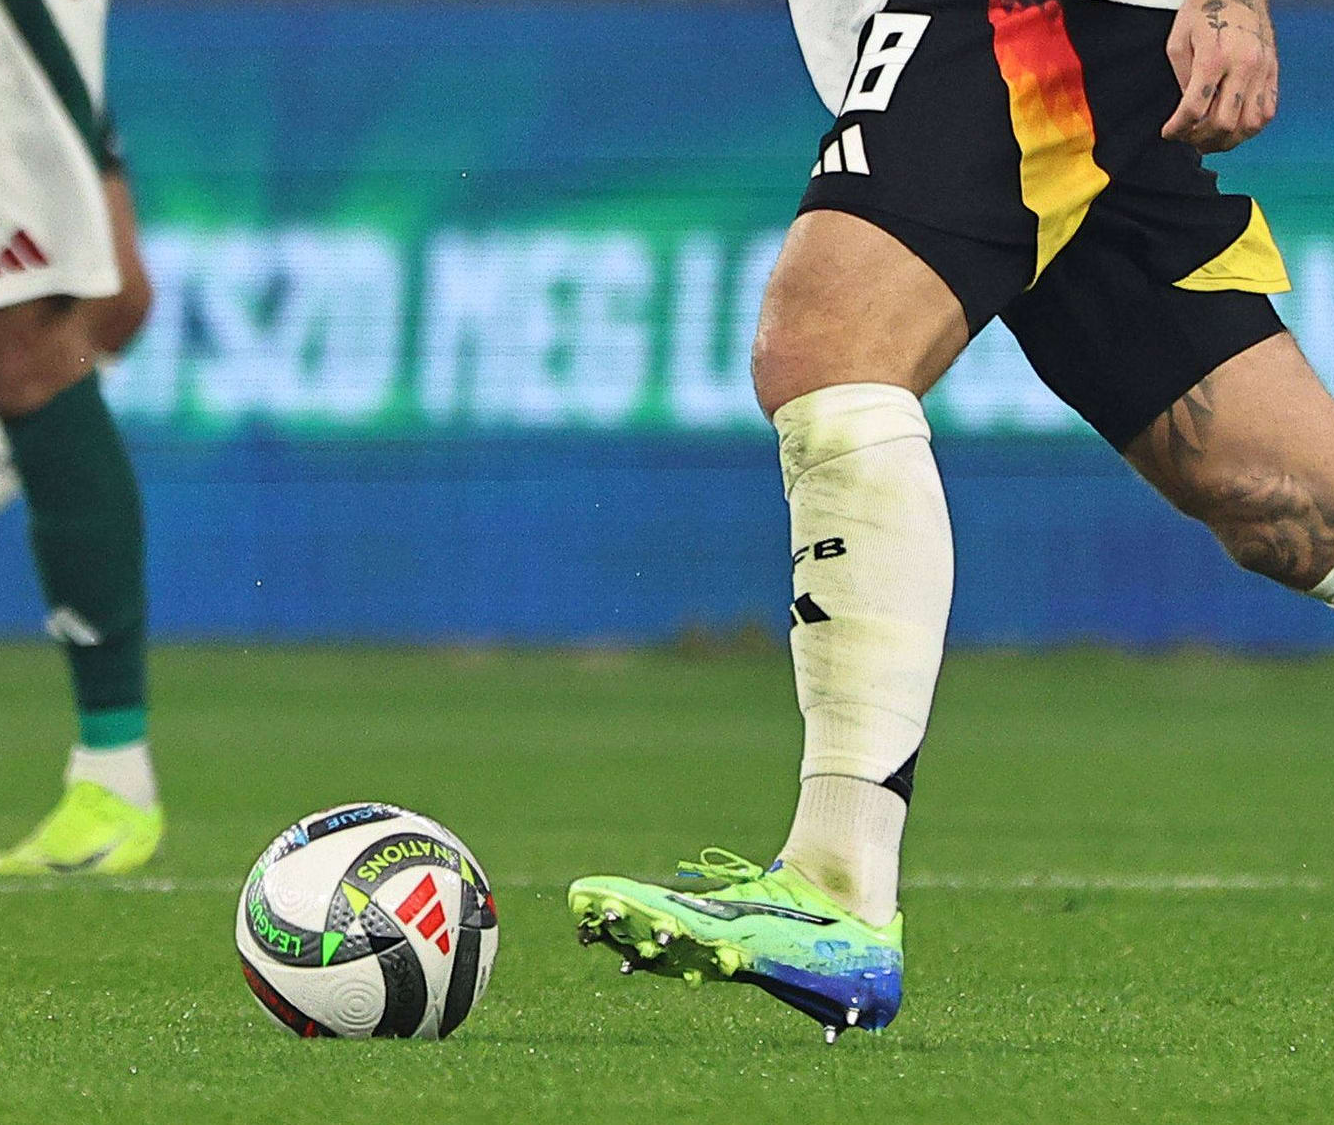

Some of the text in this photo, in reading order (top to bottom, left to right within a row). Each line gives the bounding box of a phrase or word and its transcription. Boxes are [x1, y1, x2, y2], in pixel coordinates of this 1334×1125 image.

[838, 11, 932, 118] 8
[417, 225, 657, 431] MEG
[793, 537, 847, 565] FB
[357, 839, 452, 883] NATIONS
